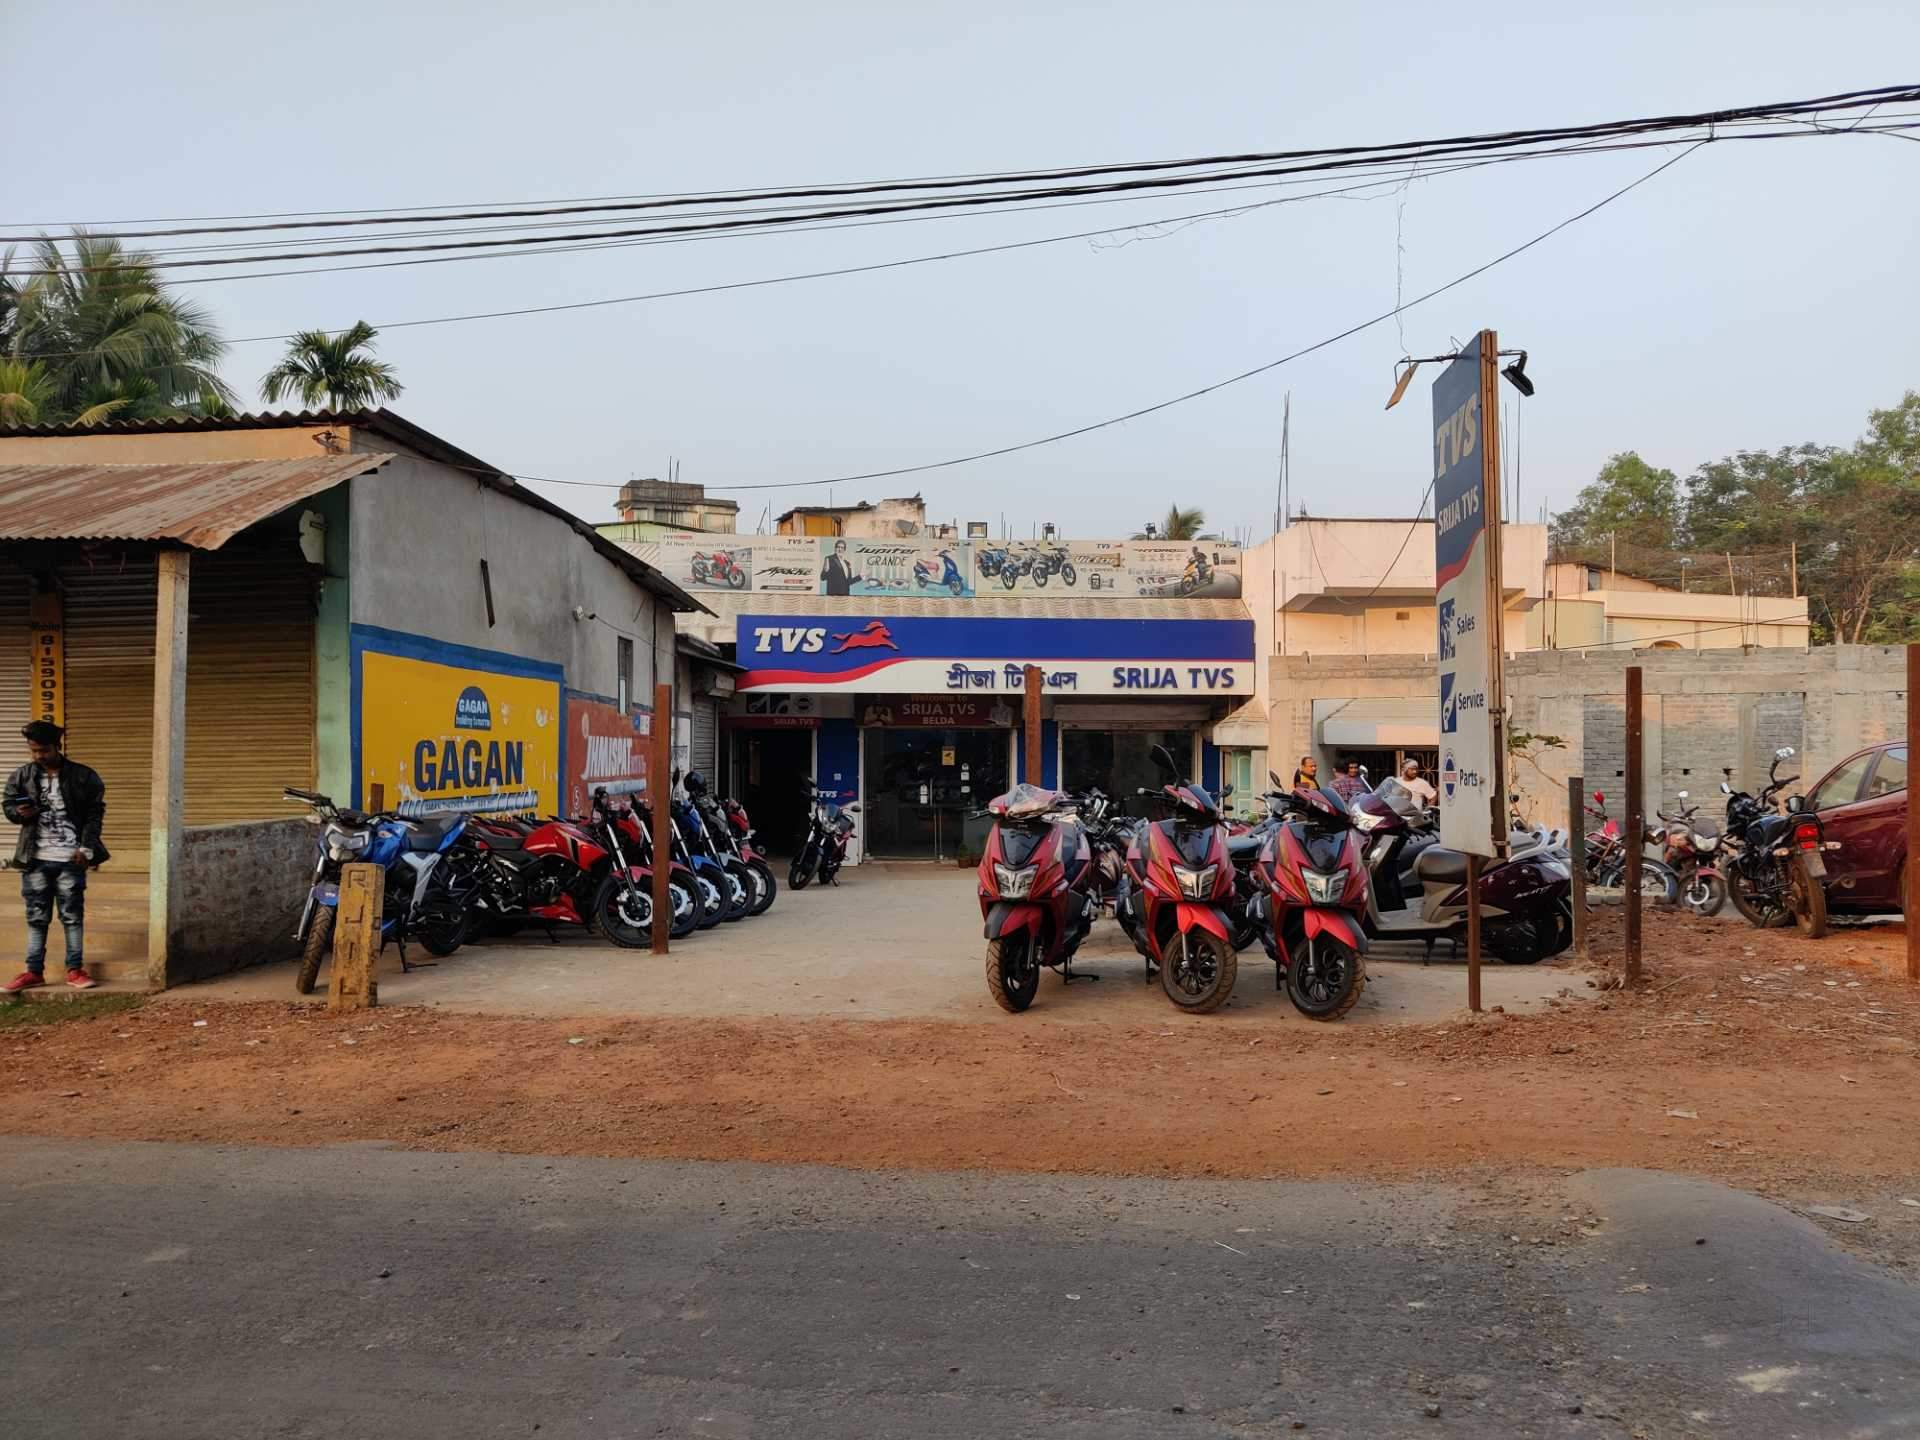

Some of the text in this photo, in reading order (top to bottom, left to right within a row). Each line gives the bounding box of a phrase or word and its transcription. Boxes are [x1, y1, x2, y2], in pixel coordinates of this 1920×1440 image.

[1436, 392, 1478, 479] TVS
[1438, 484, 1480, 537] SRIJA TVS
[867, 556, 909, 567] GRANDE
[1456, 610, 1475, 636] Sales
[754, 627, 827, 653] TVS
[946, 663, 995, 690] শ্রীজা
[1112, 666, 1235, 689] SRIJA TVS
[459, 699, 488, 714] GAGAN
[902, 703, 977, 715] SRIJA TVS
[1458, 688, 1484, 711] Service
[922, 716, 955, 725] BELDA
[414, 739, 523, 792] GAGAN
[1459, 768, 1478, 787] Parts
[818, 790, 838, 799] TVS
